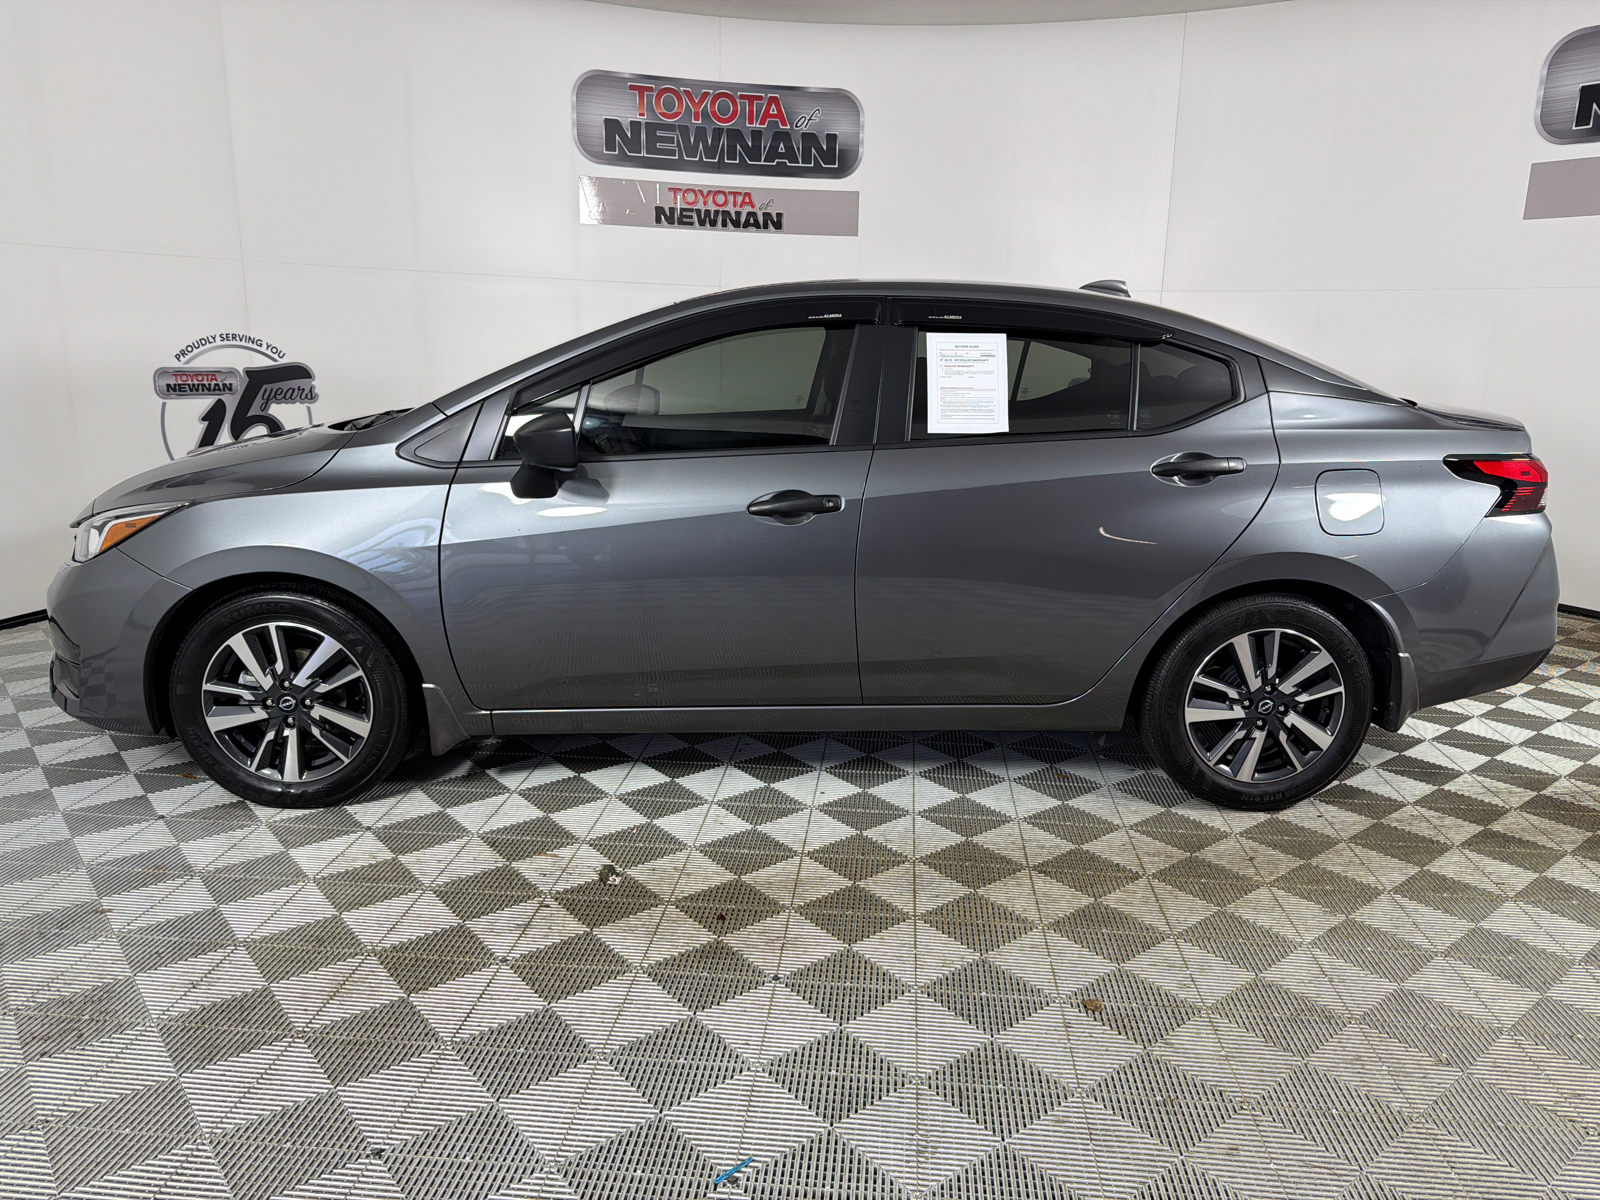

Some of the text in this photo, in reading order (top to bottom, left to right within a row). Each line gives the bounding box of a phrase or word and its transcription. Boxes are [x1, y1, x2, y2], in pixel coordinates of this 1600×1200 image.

[628, 82, 821, 130] TOYOTA of
[603, 117, 838, 167] NEWNAN
[667, 187, 774, 211] TOYOTA of
[654, 206, 783, 230] NEWNAN
[174, 333, 286, 362] PROUDLY SERVING YOU
[165, 383, 233, 393] NEWNAN
[172, 373, 218, 383] TOYOTA
[198, 365, 313, 450] 15
[260, 384, 317, 412] years
[222, 603, 290, 626] KUMHO
